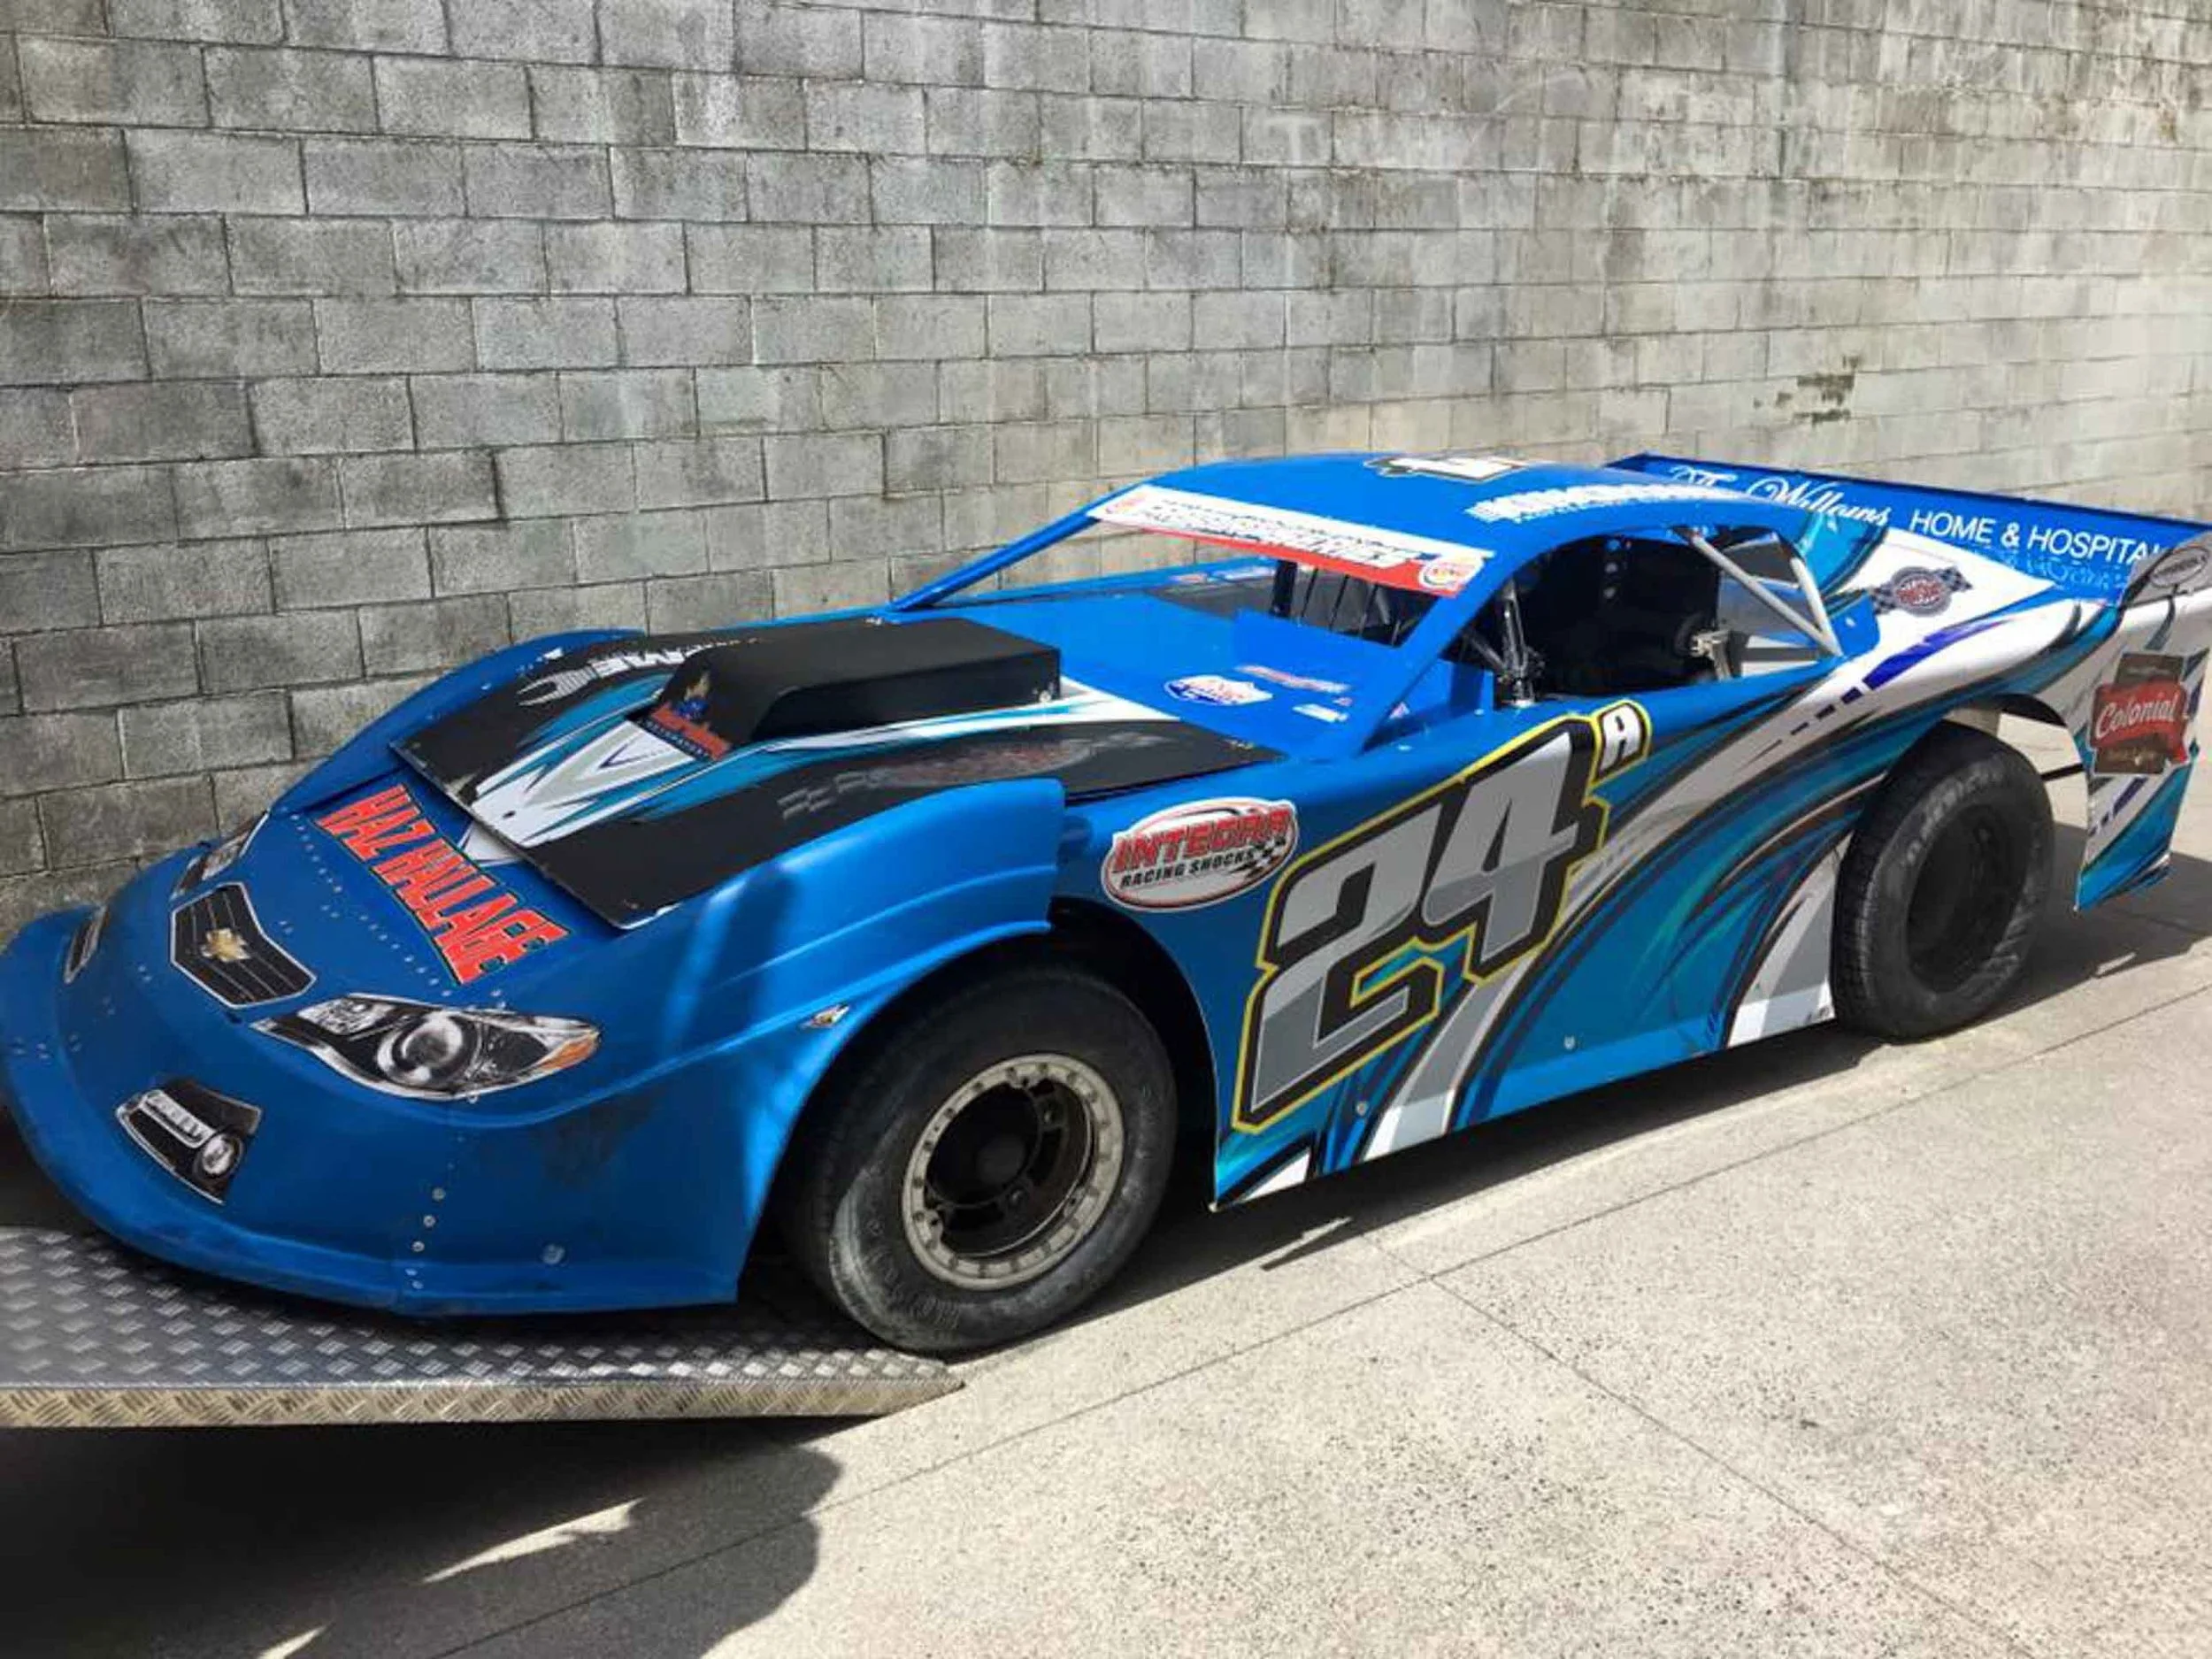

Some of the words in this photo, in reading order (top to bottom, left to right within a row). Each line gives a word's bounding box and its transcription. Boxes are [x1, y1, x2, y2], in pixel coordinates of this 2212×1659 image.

[1908, 509, 1996, 544] HOME
[2001, 522, 2020, 548] &
[2094, 693, 2180, 741] Colonial
[313, 783, 436, 863] HAZ
[1113, 806, 1293, 872] INTEGRA
[1121, 864, 1186, 887] RACING
[1189, 849, 1255, 873] SHOCKS
[1242, 720, 1591, 1122] 24
